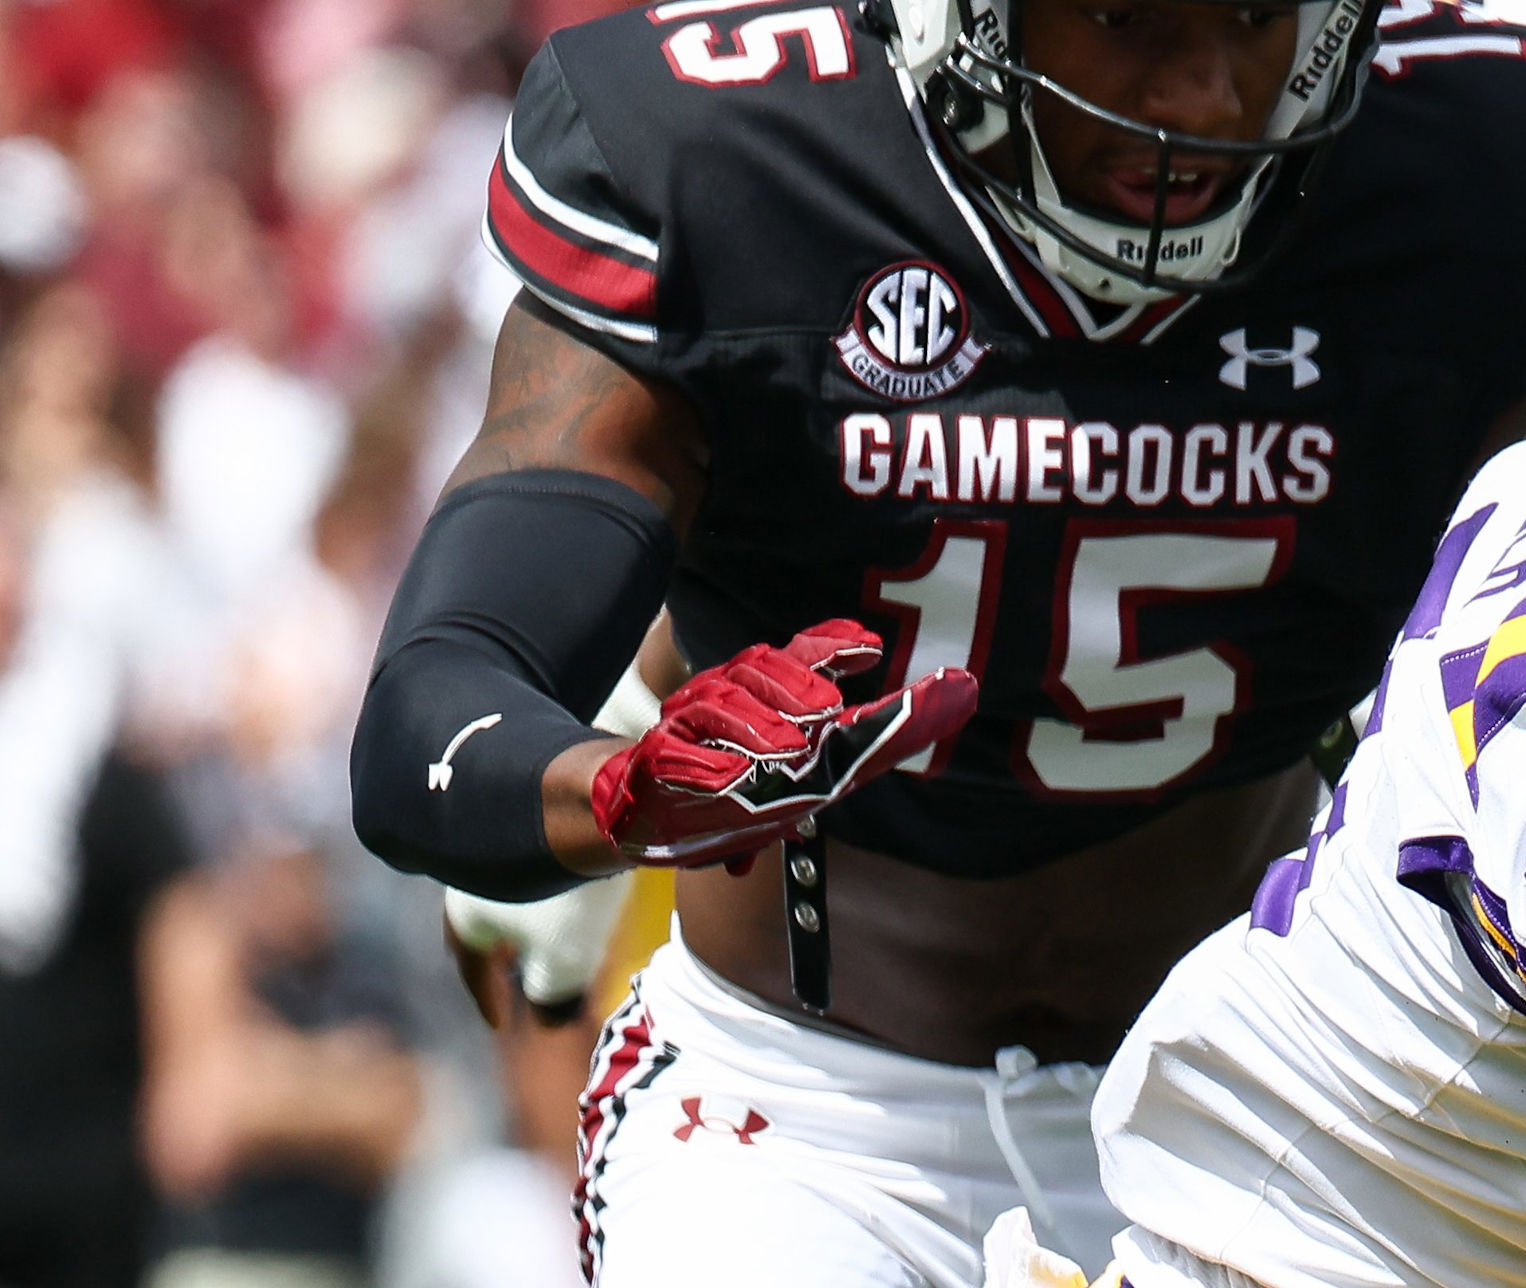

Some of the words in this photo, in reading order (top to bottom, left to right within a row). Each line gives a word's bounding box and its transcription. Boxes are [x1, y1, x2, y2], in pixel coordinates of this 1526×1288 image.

[1117, 236, 1203, 261] Ridell
[866, 266, 957, 366] SEC
[852, 353, 966, 399] GRADUATE
[840, 412, 1335, 506] GAMECOCKS
[864, 516, 1297, 801] 15
